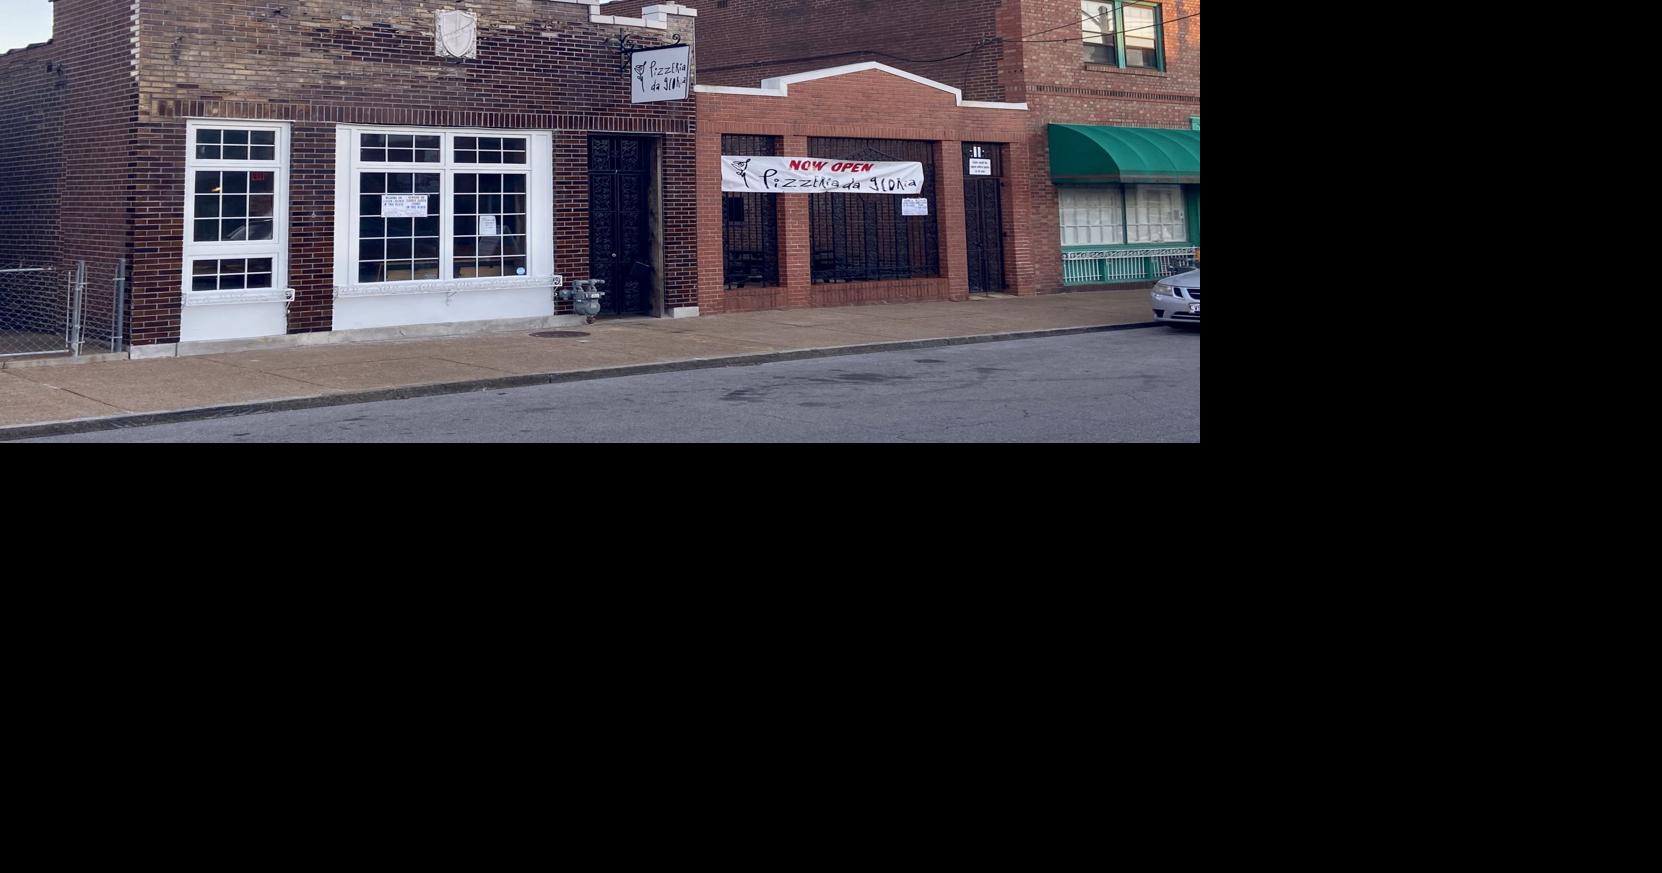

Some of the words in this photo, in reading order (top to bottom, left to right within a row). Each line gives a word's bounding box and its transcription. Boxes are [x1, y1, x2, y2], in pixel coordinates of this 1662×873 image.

[650, 80, 660, 91] da
[788, 159, 829, 172] NOW
[831, 162, 875, 173] OPEN
[842, 178, 861, 190] da
